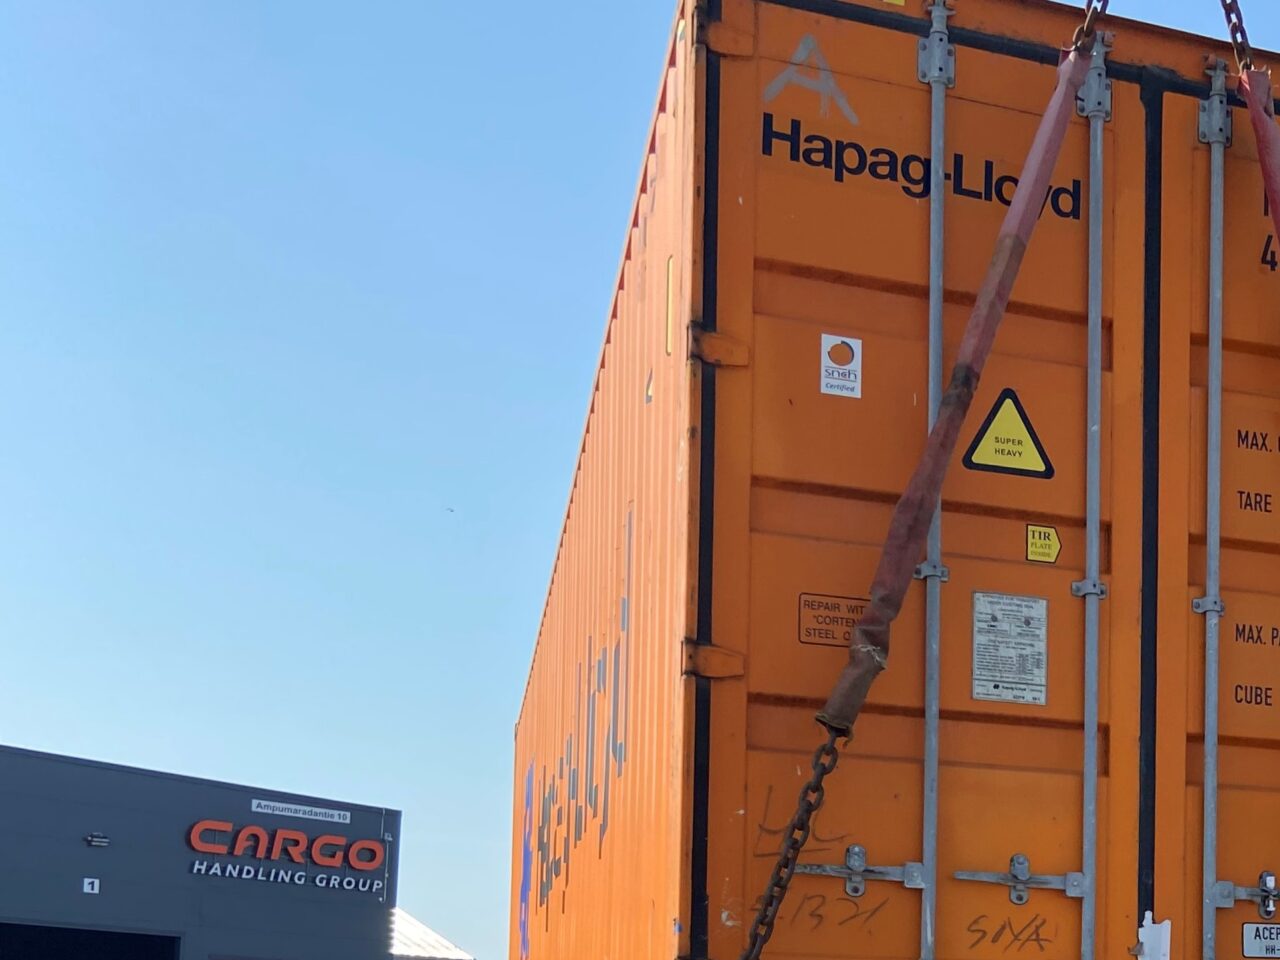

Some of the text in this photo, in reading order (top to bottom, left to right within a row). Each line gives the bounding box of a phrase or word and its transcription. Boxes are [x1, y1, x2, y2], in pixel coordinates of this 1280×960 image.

[994, 436, 1023, 446] SUPER
[1237, 429, 1272, 453] MAX.
[994, 448, 1023, 457] HEAVY
[1237, 490, 1272, 513] TARE
[1030, 530, 1051, 541] TIR
[803, 600, 865, 615] REPAIR WIT
[804, 627, 837, 640] STEEL
[1235, 624, 1266, 645] MAX.
[1235, 684, 1273, 707] CUBE
[337, 812, 348, 822] 10
[189, 819, 385, 871] CARGO
[192, 859, 383, 893] HANDLING GROUP
